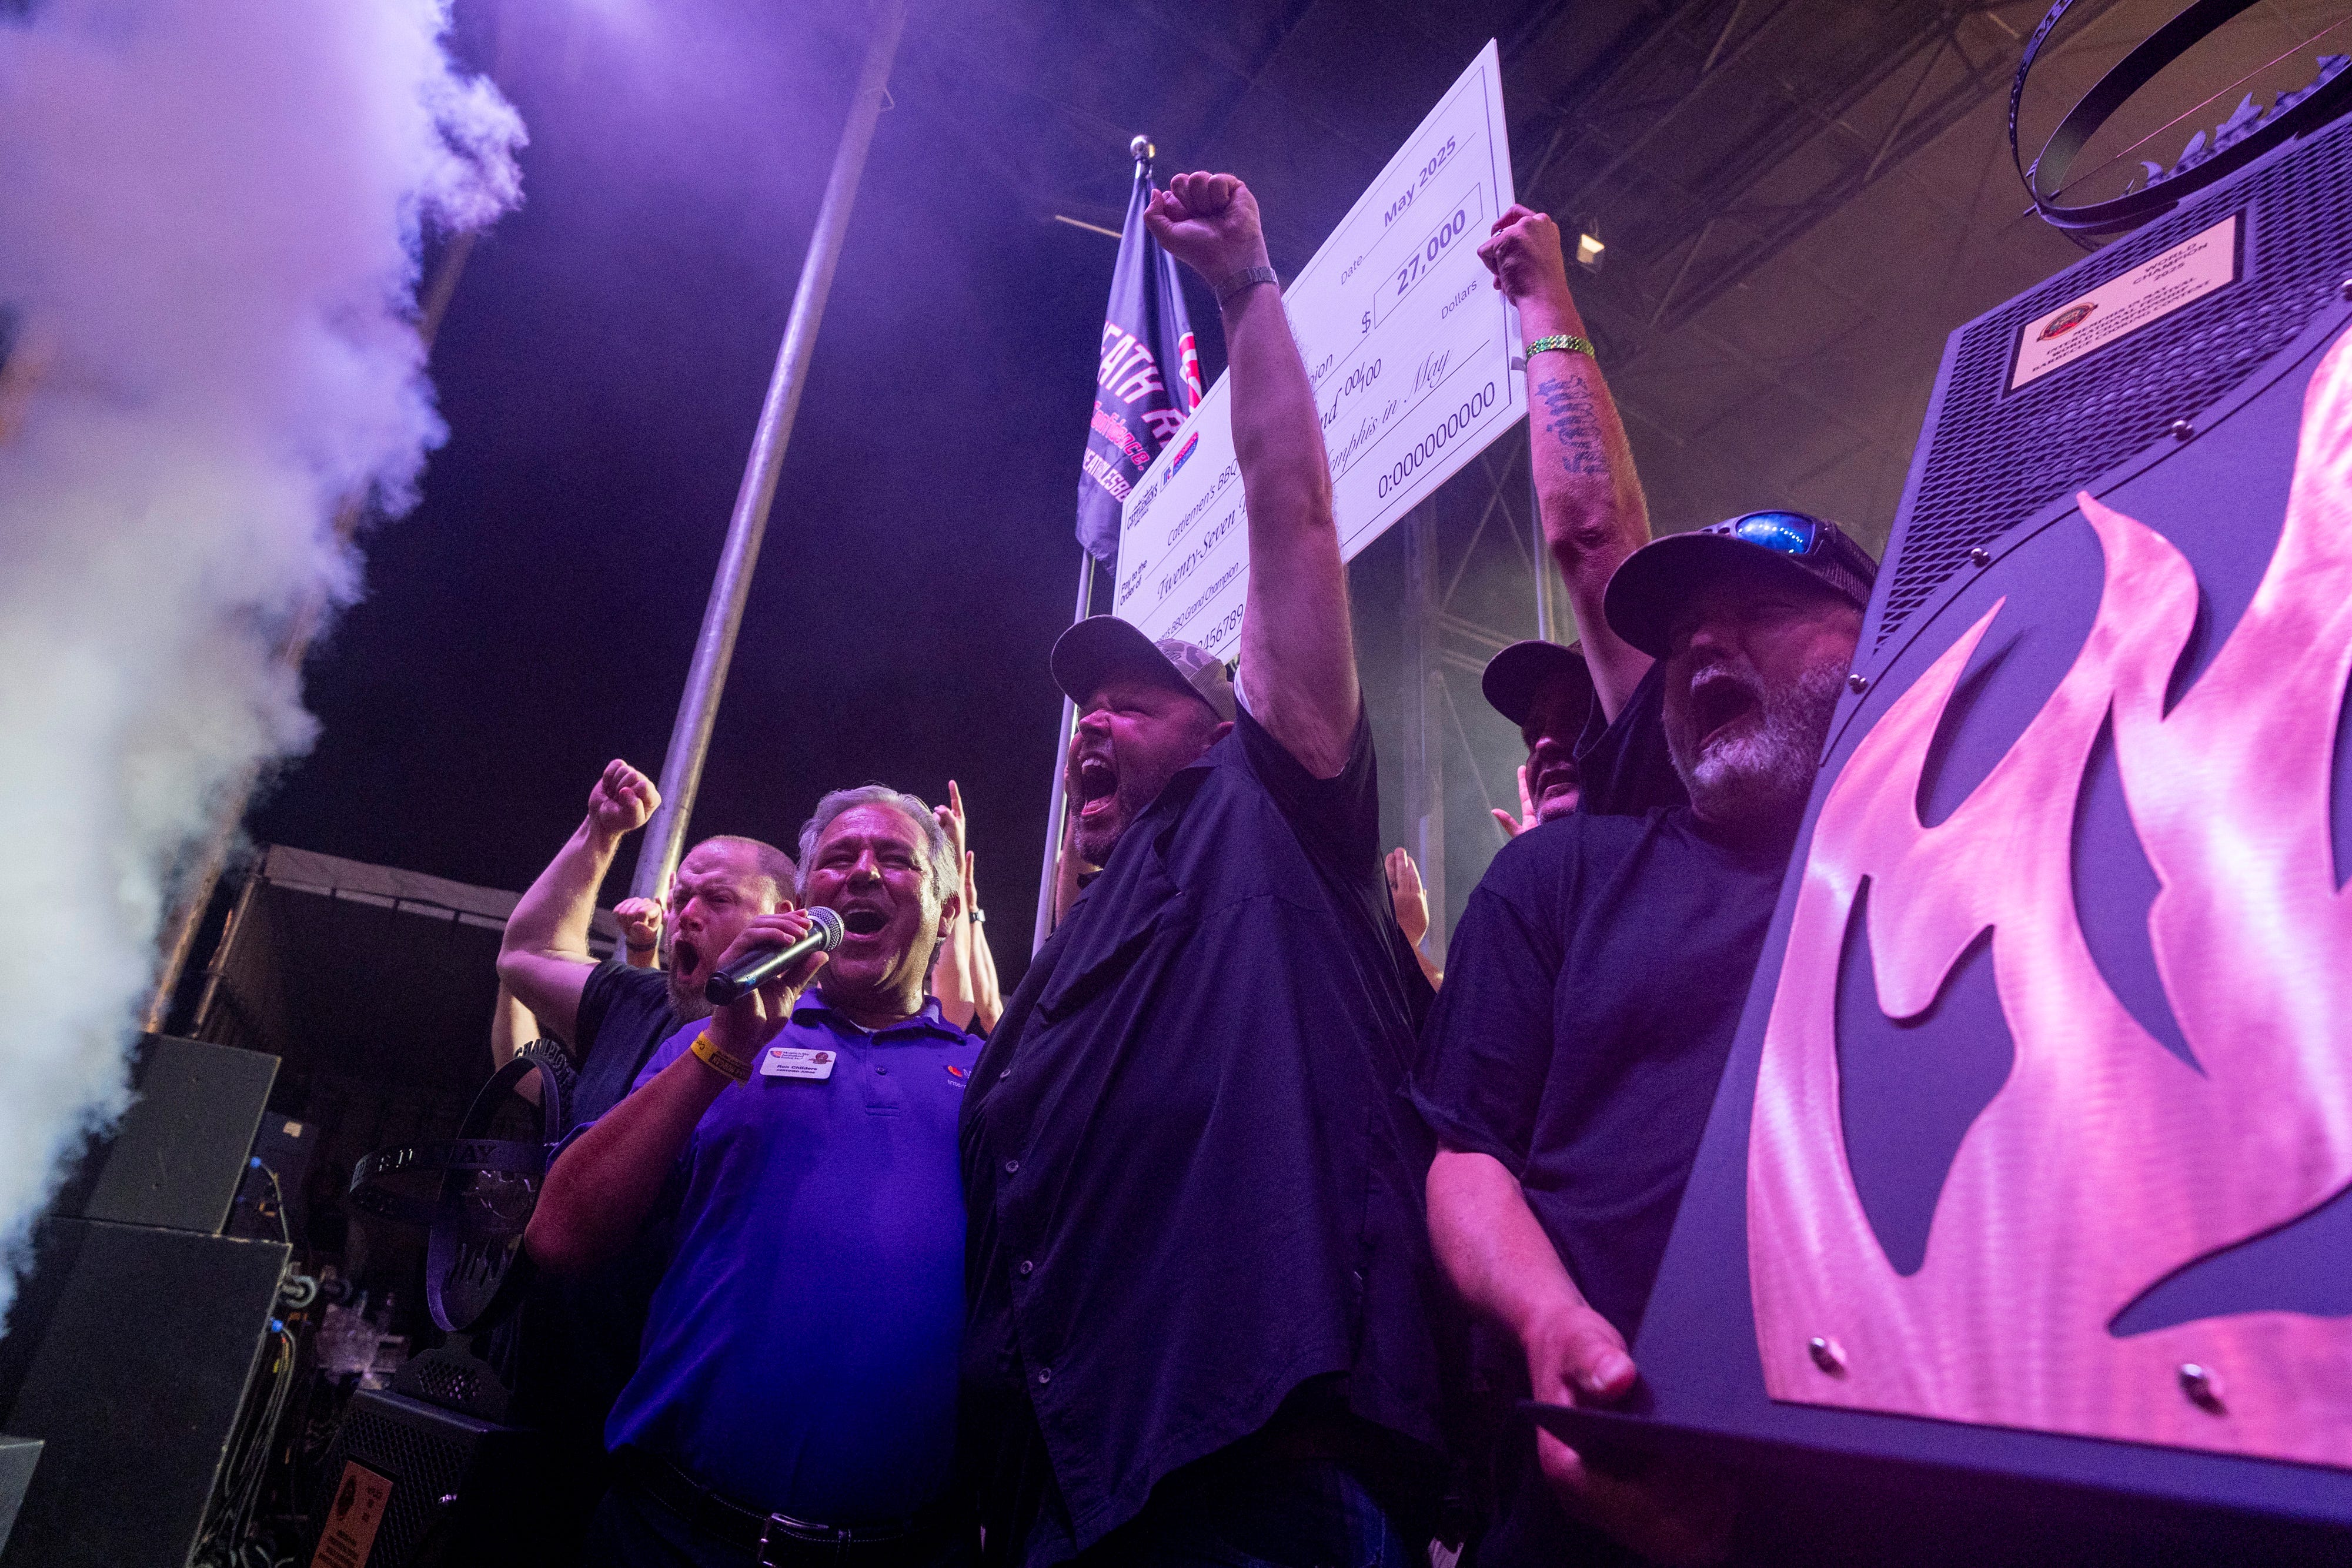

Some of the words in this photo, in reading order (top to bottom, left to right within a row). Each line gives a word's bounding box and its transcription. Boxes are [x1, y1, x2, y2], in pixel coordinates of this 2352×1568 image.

[1342, 255, 1362, 285] Date
[1385, 183, 1415, 227] May
[1419, 135, 1455, 188] 2025
[1361, 310, 1371, 333] $
[1397, 209, 1465, 296] 27,000
[2133, 242, 2207, 285] CHAMPION
[2145, 242, 2196, 272] WORLD
[1441, 280, 1477, 319] Dollars
[1167, 484, 1215, 546] Cattlemen's
[1217, 457, 1238, 491] BBQ
[1121, 576, 1131, 593] Pay
[1138, 560, 1147, 574] the
[1157, 509, 1235, 601] Twenty-Seven
[1120, 584, 1135, 606] Order
[1185, 591, 1205, 620] Grand
[1205, 562, 1239, 601] Champion
